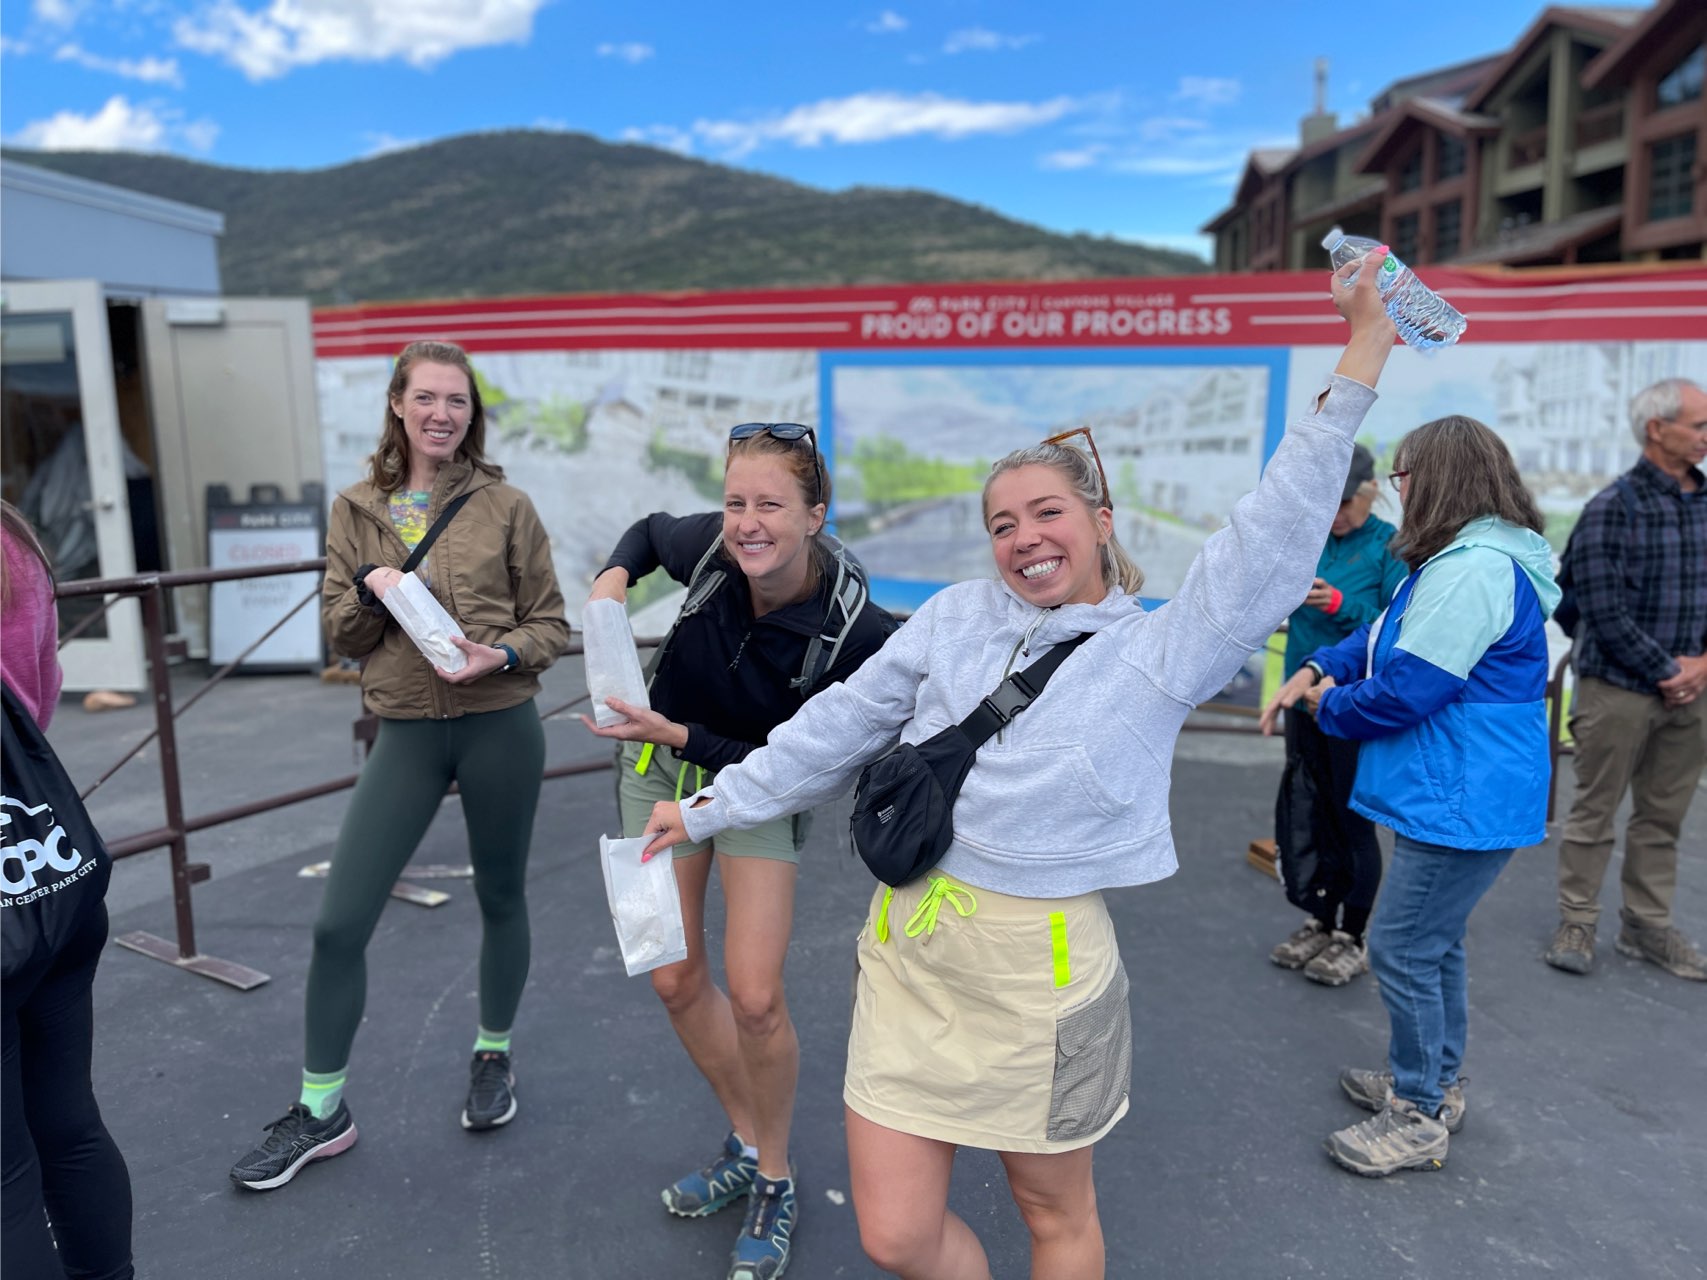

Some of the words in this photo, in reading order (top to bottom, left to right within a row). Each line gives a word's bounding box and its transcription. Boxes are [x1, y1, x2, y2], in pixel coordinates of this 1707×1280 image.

[861, 313, 952, 339] PROUD
[957, 311, 996, 337] OF
[1003, 310, 1065, 337] OUR
[1072, 307, 1232, 335] PROGRESS
[15, 886, 51, 906] CENTER
[51, 872, 79, 892] PARK
[77, 857, 97, 877] CITY
